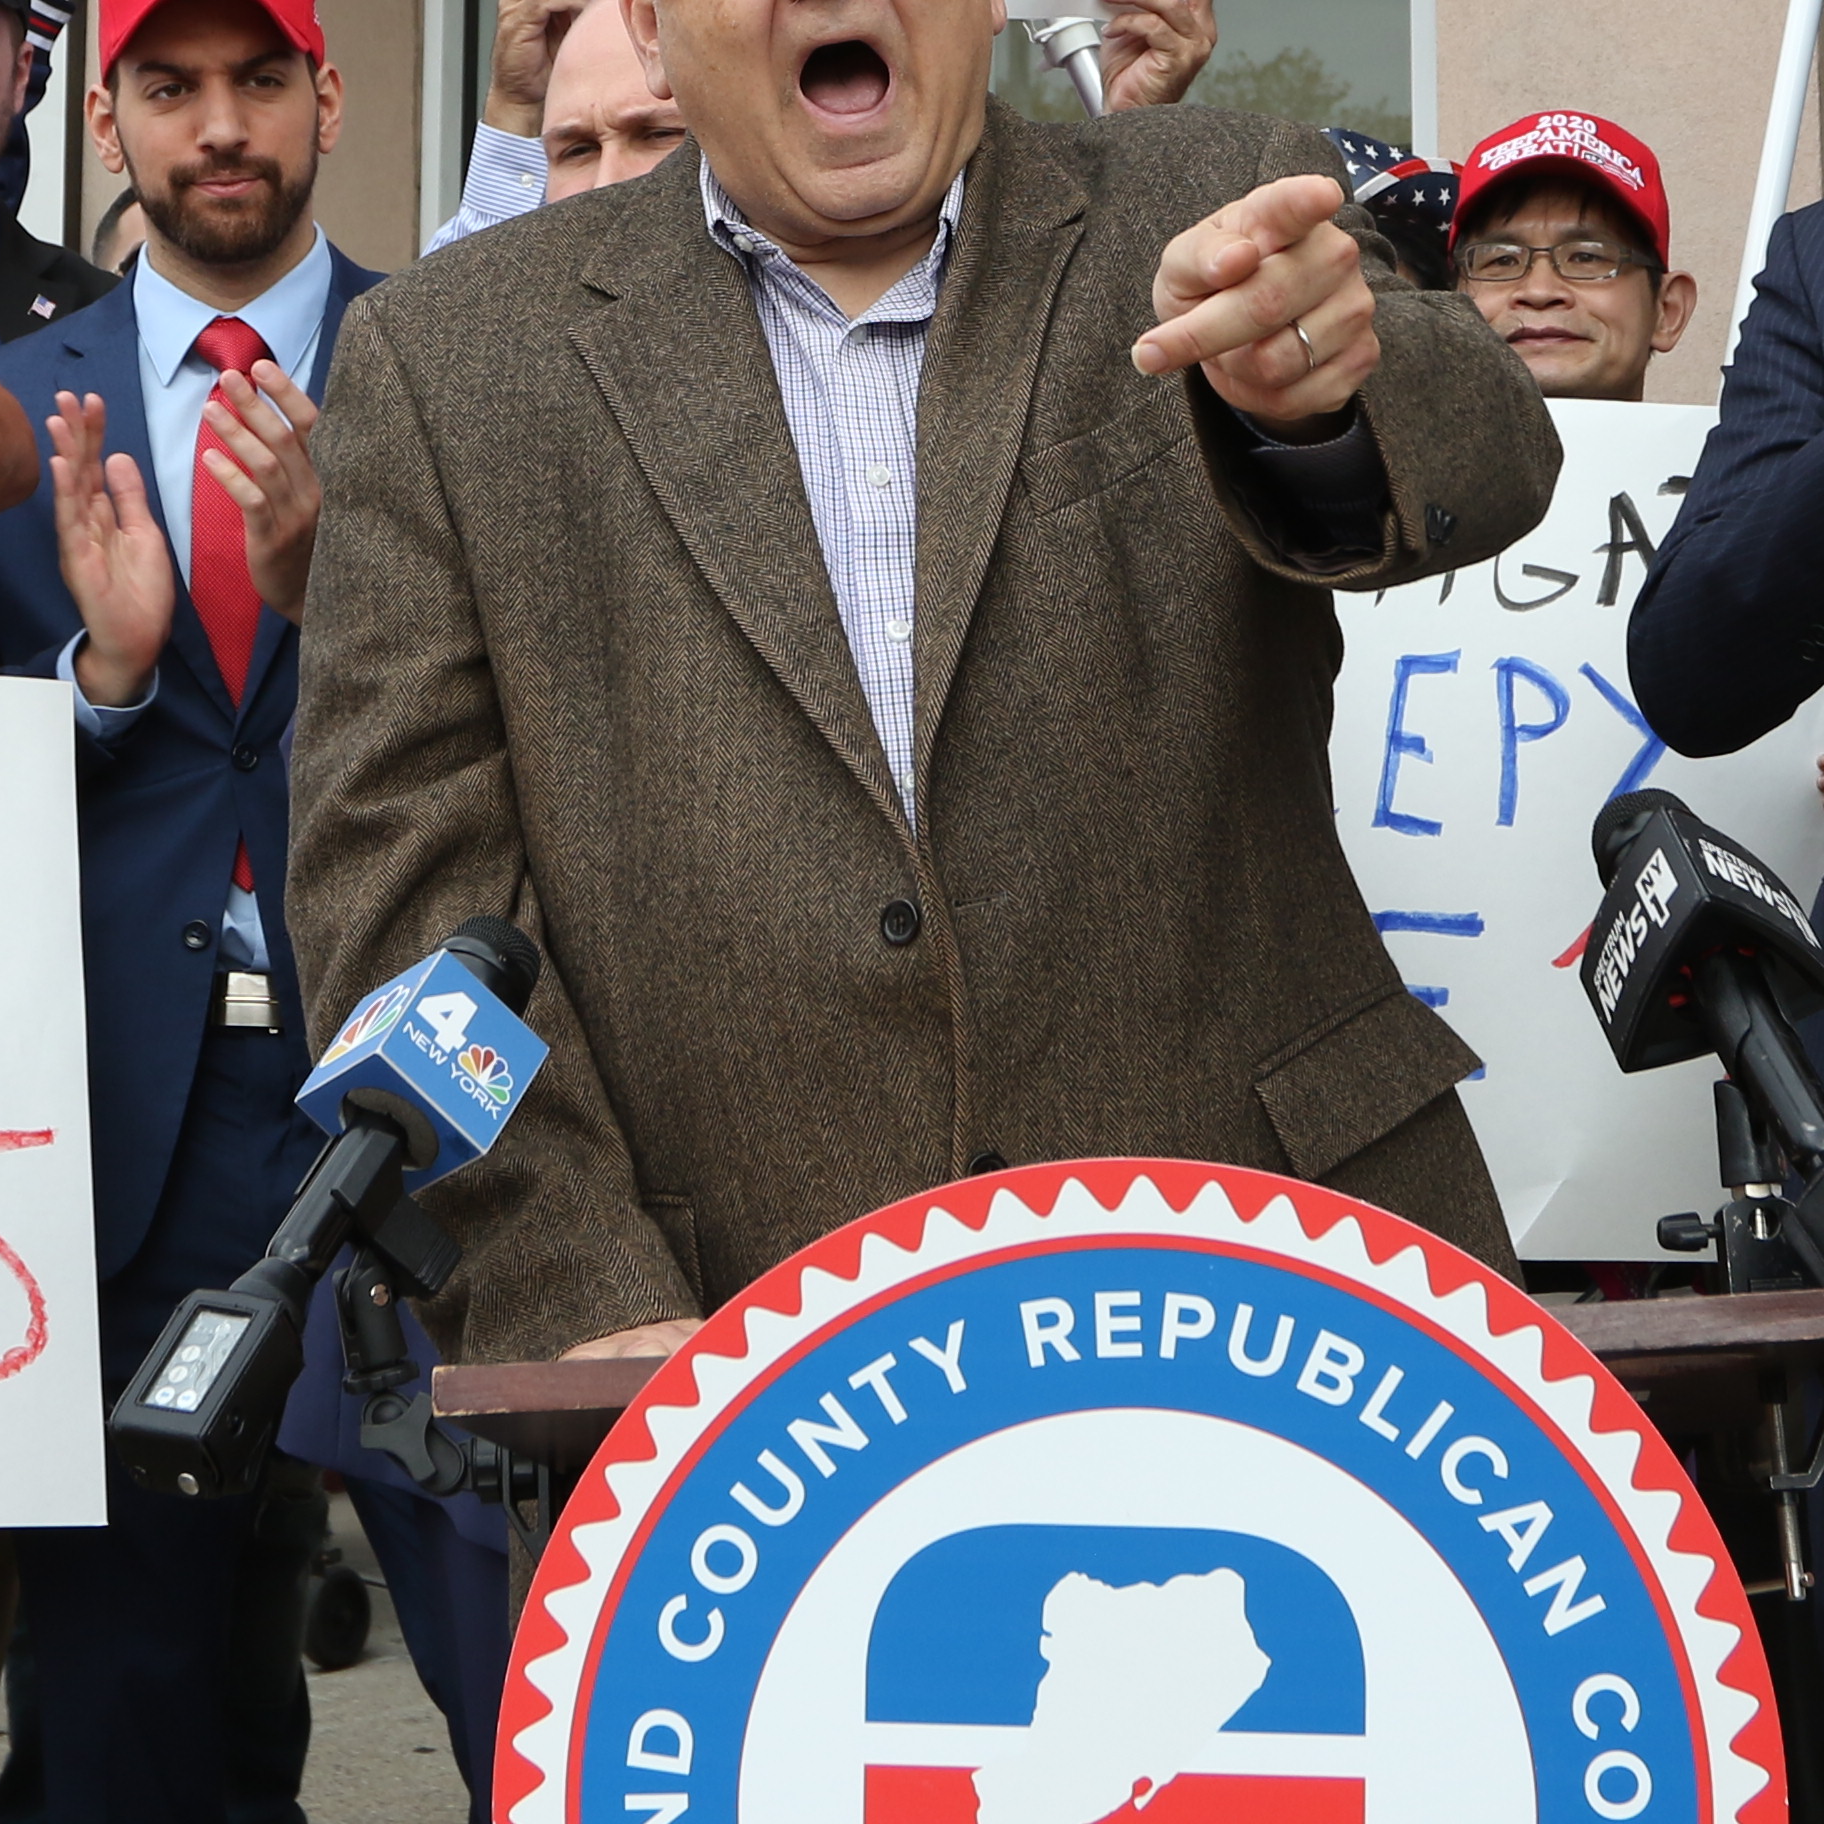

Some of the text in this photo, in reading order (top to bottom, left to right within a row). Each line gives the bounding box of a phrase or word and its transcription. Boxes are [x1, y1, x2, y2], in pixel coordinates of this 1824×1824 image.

[1478, 127, 1645, 187] KEEP AMERICA
[1536, 114, 1597, 135] 2020
[1698, 838, 1764, 880] SPECTRUM
[1703, 851, 1792, 919] NEWS
[1593, 911, 1626, 991] SPECTRUM
[1597, 902, 1649, 1024] NEWS
[416, 992, 478, 1053] 4
[403, 1021, 502, 1120] NEW YORK
[658, 1319, 966, 1663] COUNTY
[1019, 1291, 1607, 1636] REPUBLICAN
